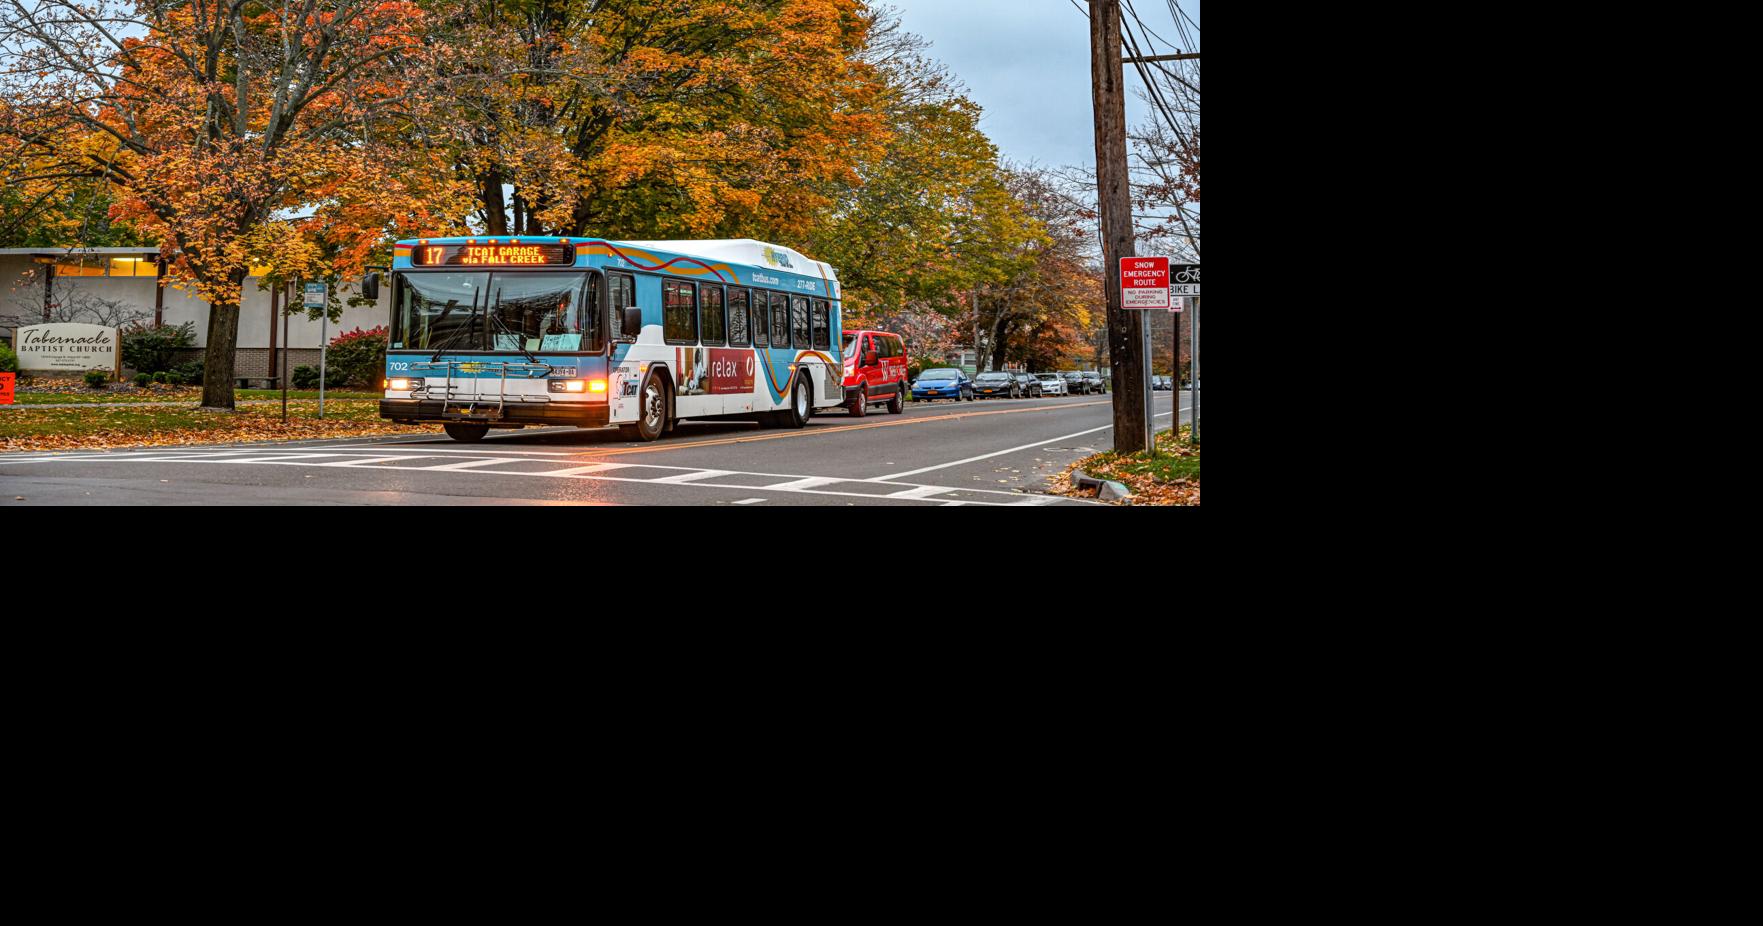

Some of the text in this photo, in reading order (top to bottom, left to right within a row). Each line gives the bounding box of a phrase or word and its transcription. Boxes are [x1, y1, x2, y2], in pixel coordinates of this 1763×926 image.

[426, 247, 443, 264] 17
[468, 247, 540, 256] TCAT GARAGE
[481, 256, 508, 264] FALL
[510, 256, 545, 264] CREEK
[24, 329, 110, 344] Tabernacle
[390, 362, 408, 371] 702
[712, 357, 737, 377] relax
